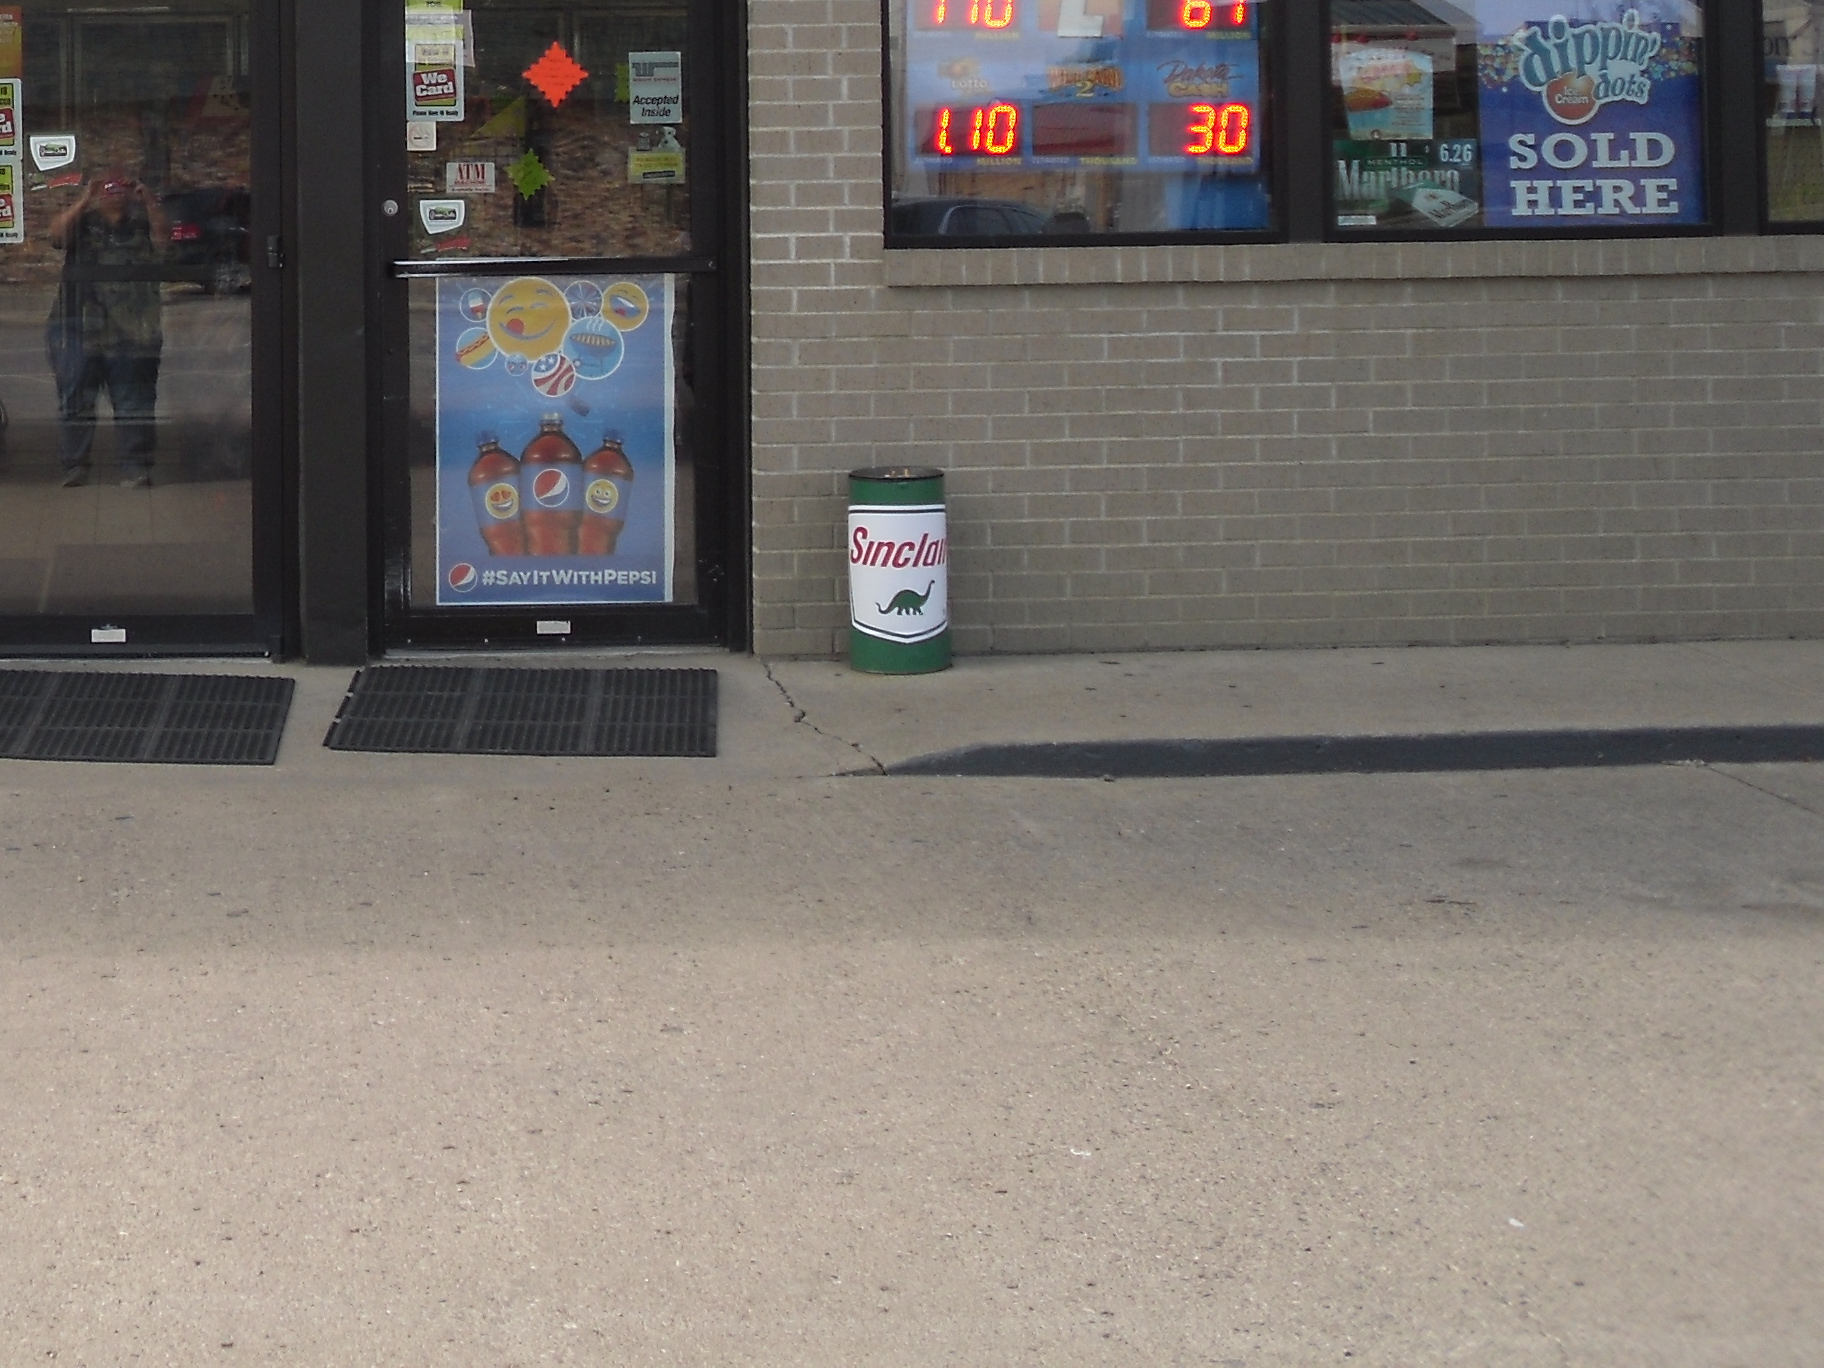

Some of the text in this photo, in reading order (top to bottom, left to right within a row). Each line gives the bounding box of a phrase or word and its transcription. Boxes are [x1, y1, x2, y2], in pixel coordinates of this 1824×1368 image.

[421, 72, 448, 85] We
[1594, 71, 1649, 103] dots
[416, 81, 454, 97] Card
[1555, 93, 1589, 104] Cream
[632, 94, 680, 107] Accepted
[641, 106, 671, 117] Inside
[1187, 104, 1250, 154] 30
[1440, 143, 1472, 162] 6.26
[1508, 132, 1675, 169] SOLD
[456, 163, 486, 183] ATM
[1510, 178, 1679, 216] HERE
